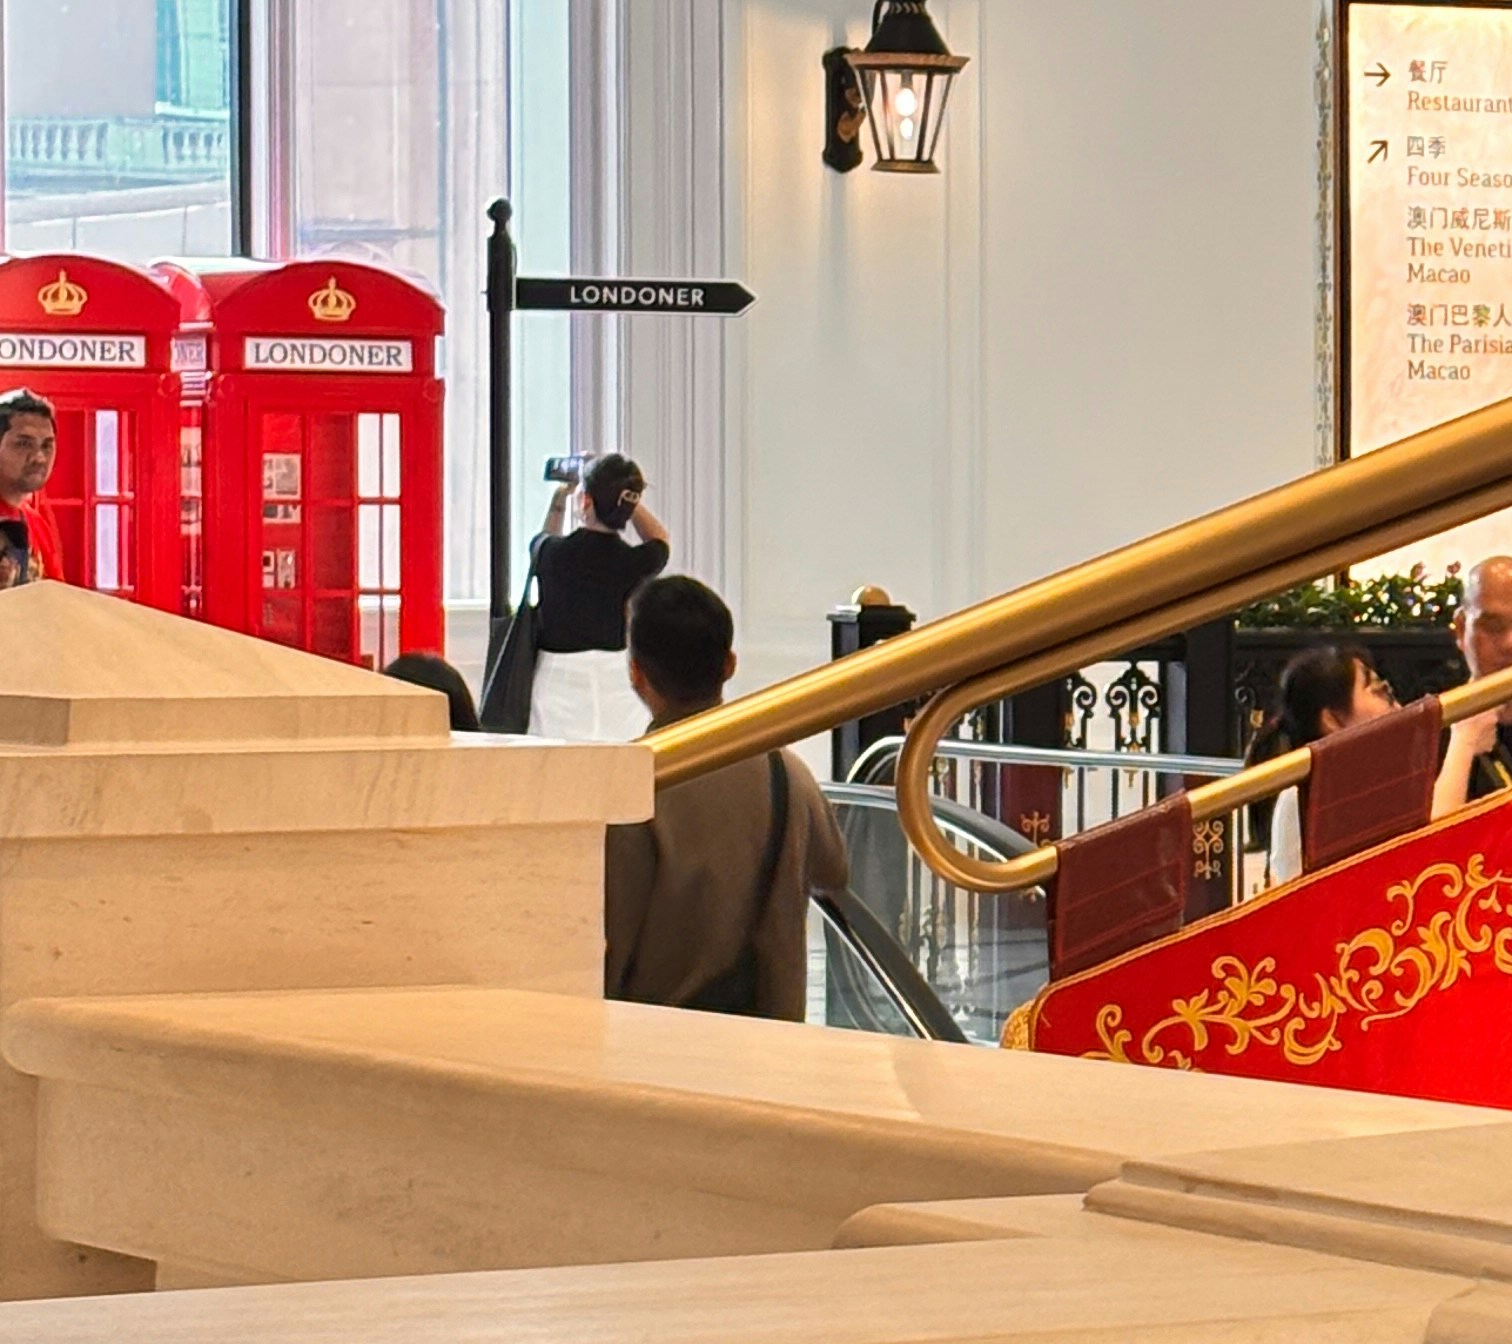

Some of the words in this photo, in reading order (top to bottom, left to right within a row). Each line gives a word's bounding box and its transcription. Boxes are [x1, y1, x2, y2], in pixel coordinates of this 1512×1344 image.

[1408, 59, 1448, 84] 餐厅
[1406, 136, 1446, 159] 四季
[1407, 165, 1451, 187] Four
[1407, 236, 1444, 257] The
[1406, 263, 1470, 284] Macao
[571, 285, 704, 306] LONDONER
[1407, 303, 1512, 328] 澳门巴黎人
[1407, 333, 1444, 354] The
[255, 343, 403, 367] LONDONER
[1406, 360, 1470, 380] Macao
